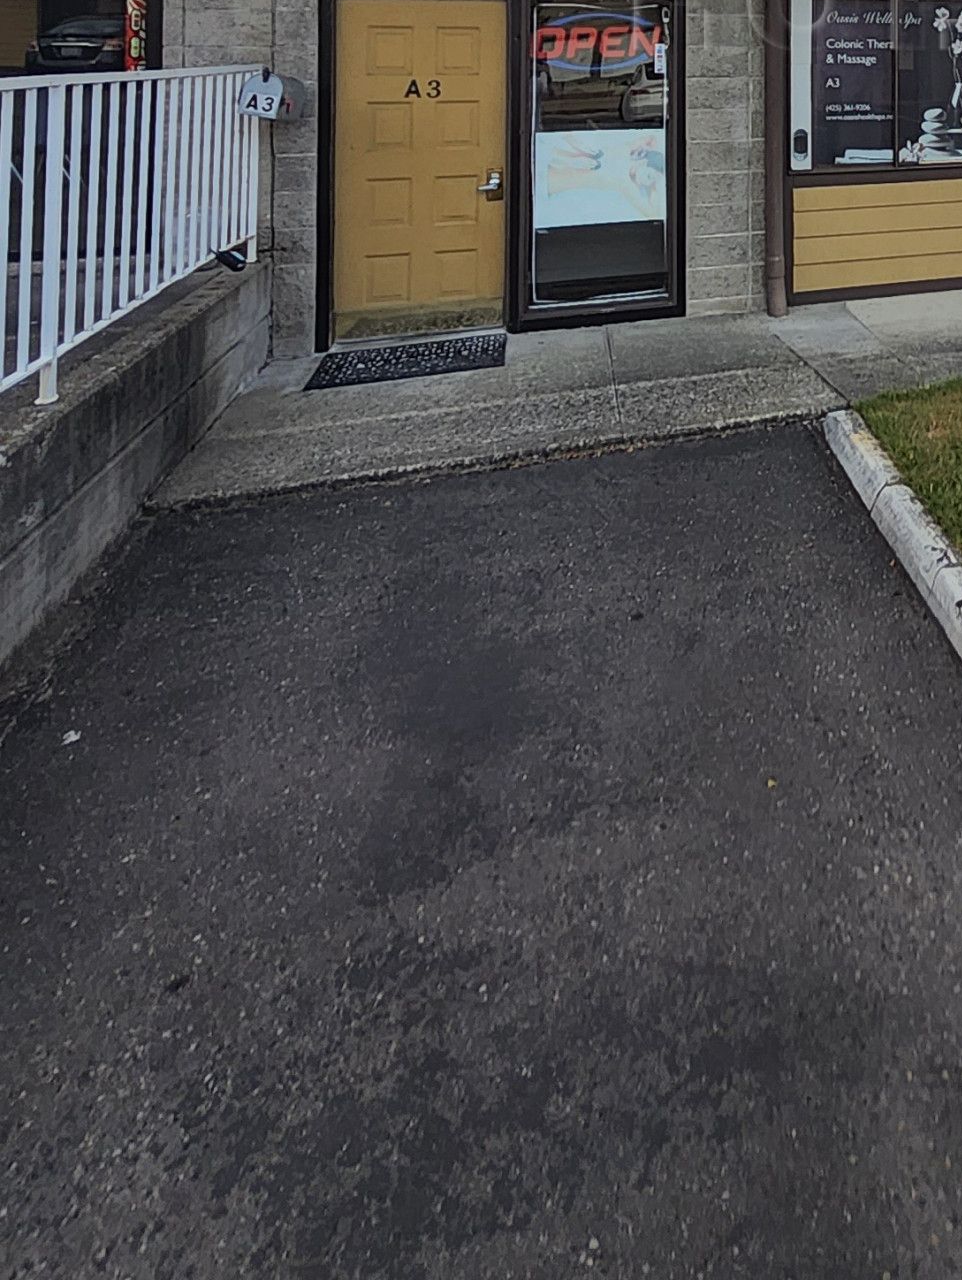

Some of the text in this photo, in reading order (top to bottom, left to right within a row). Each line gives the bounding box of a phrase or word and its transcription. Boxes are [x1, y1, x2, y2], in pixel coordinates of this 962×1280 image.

[531, 25, 661, 60] OPEN
[825, 38, 864, 50] Colonic
[825, 53, 877, 66] & Massage
[825, 77, 840, 88] A3
